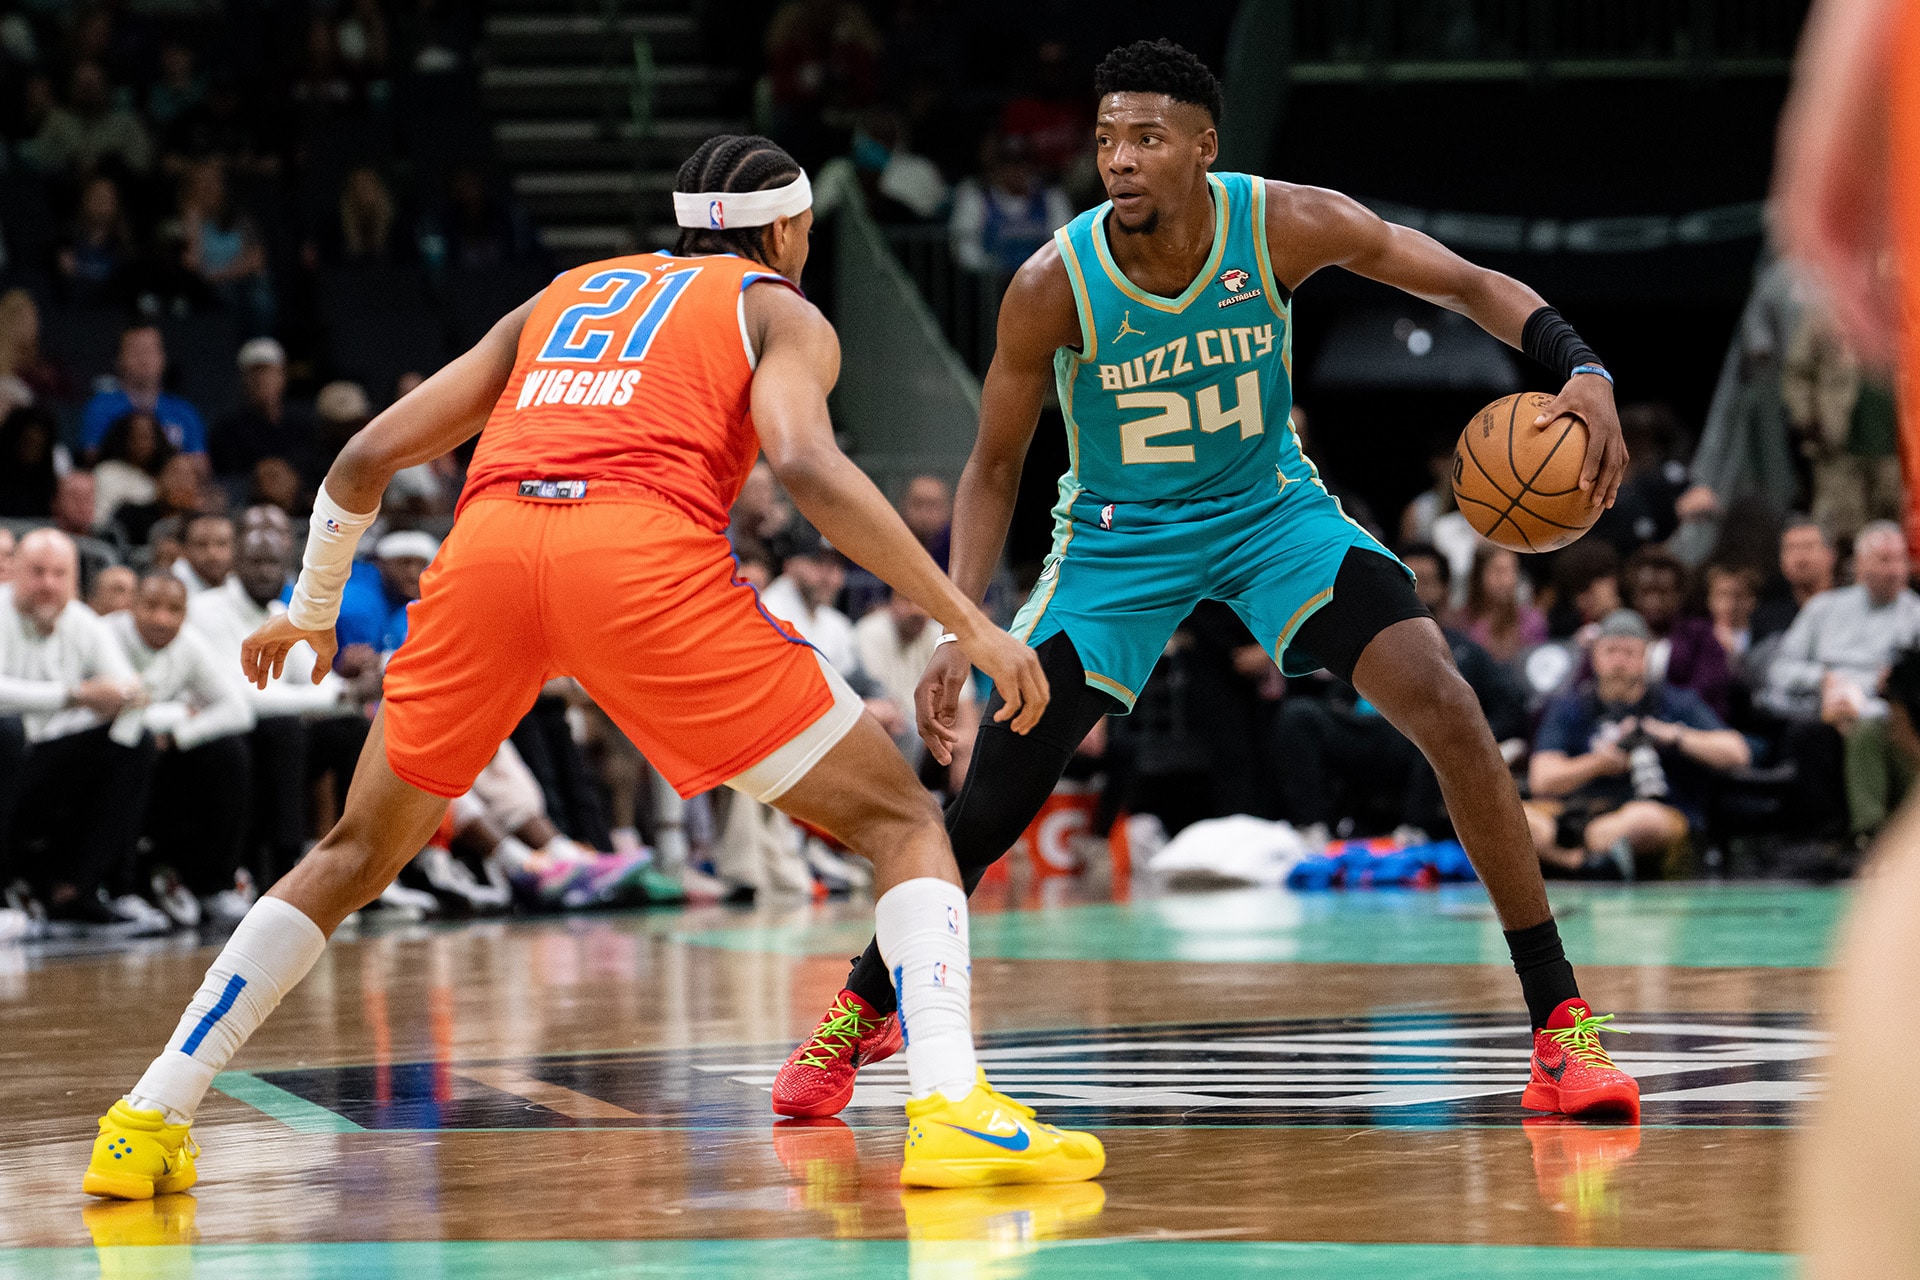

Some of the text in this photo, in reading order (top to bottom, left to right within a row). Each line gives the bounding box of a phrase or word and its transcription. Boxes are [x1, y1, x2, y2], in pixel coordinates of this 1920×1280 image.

[536, 266, 704, 363] 21
[1218, 289, 1261, 308] FEASTABLES
[515, 368, 642, 410] WIGGINS
[1096, 323, 1276, 390] BUZZ CITY
[1115, 369, 1265, 465] 24
